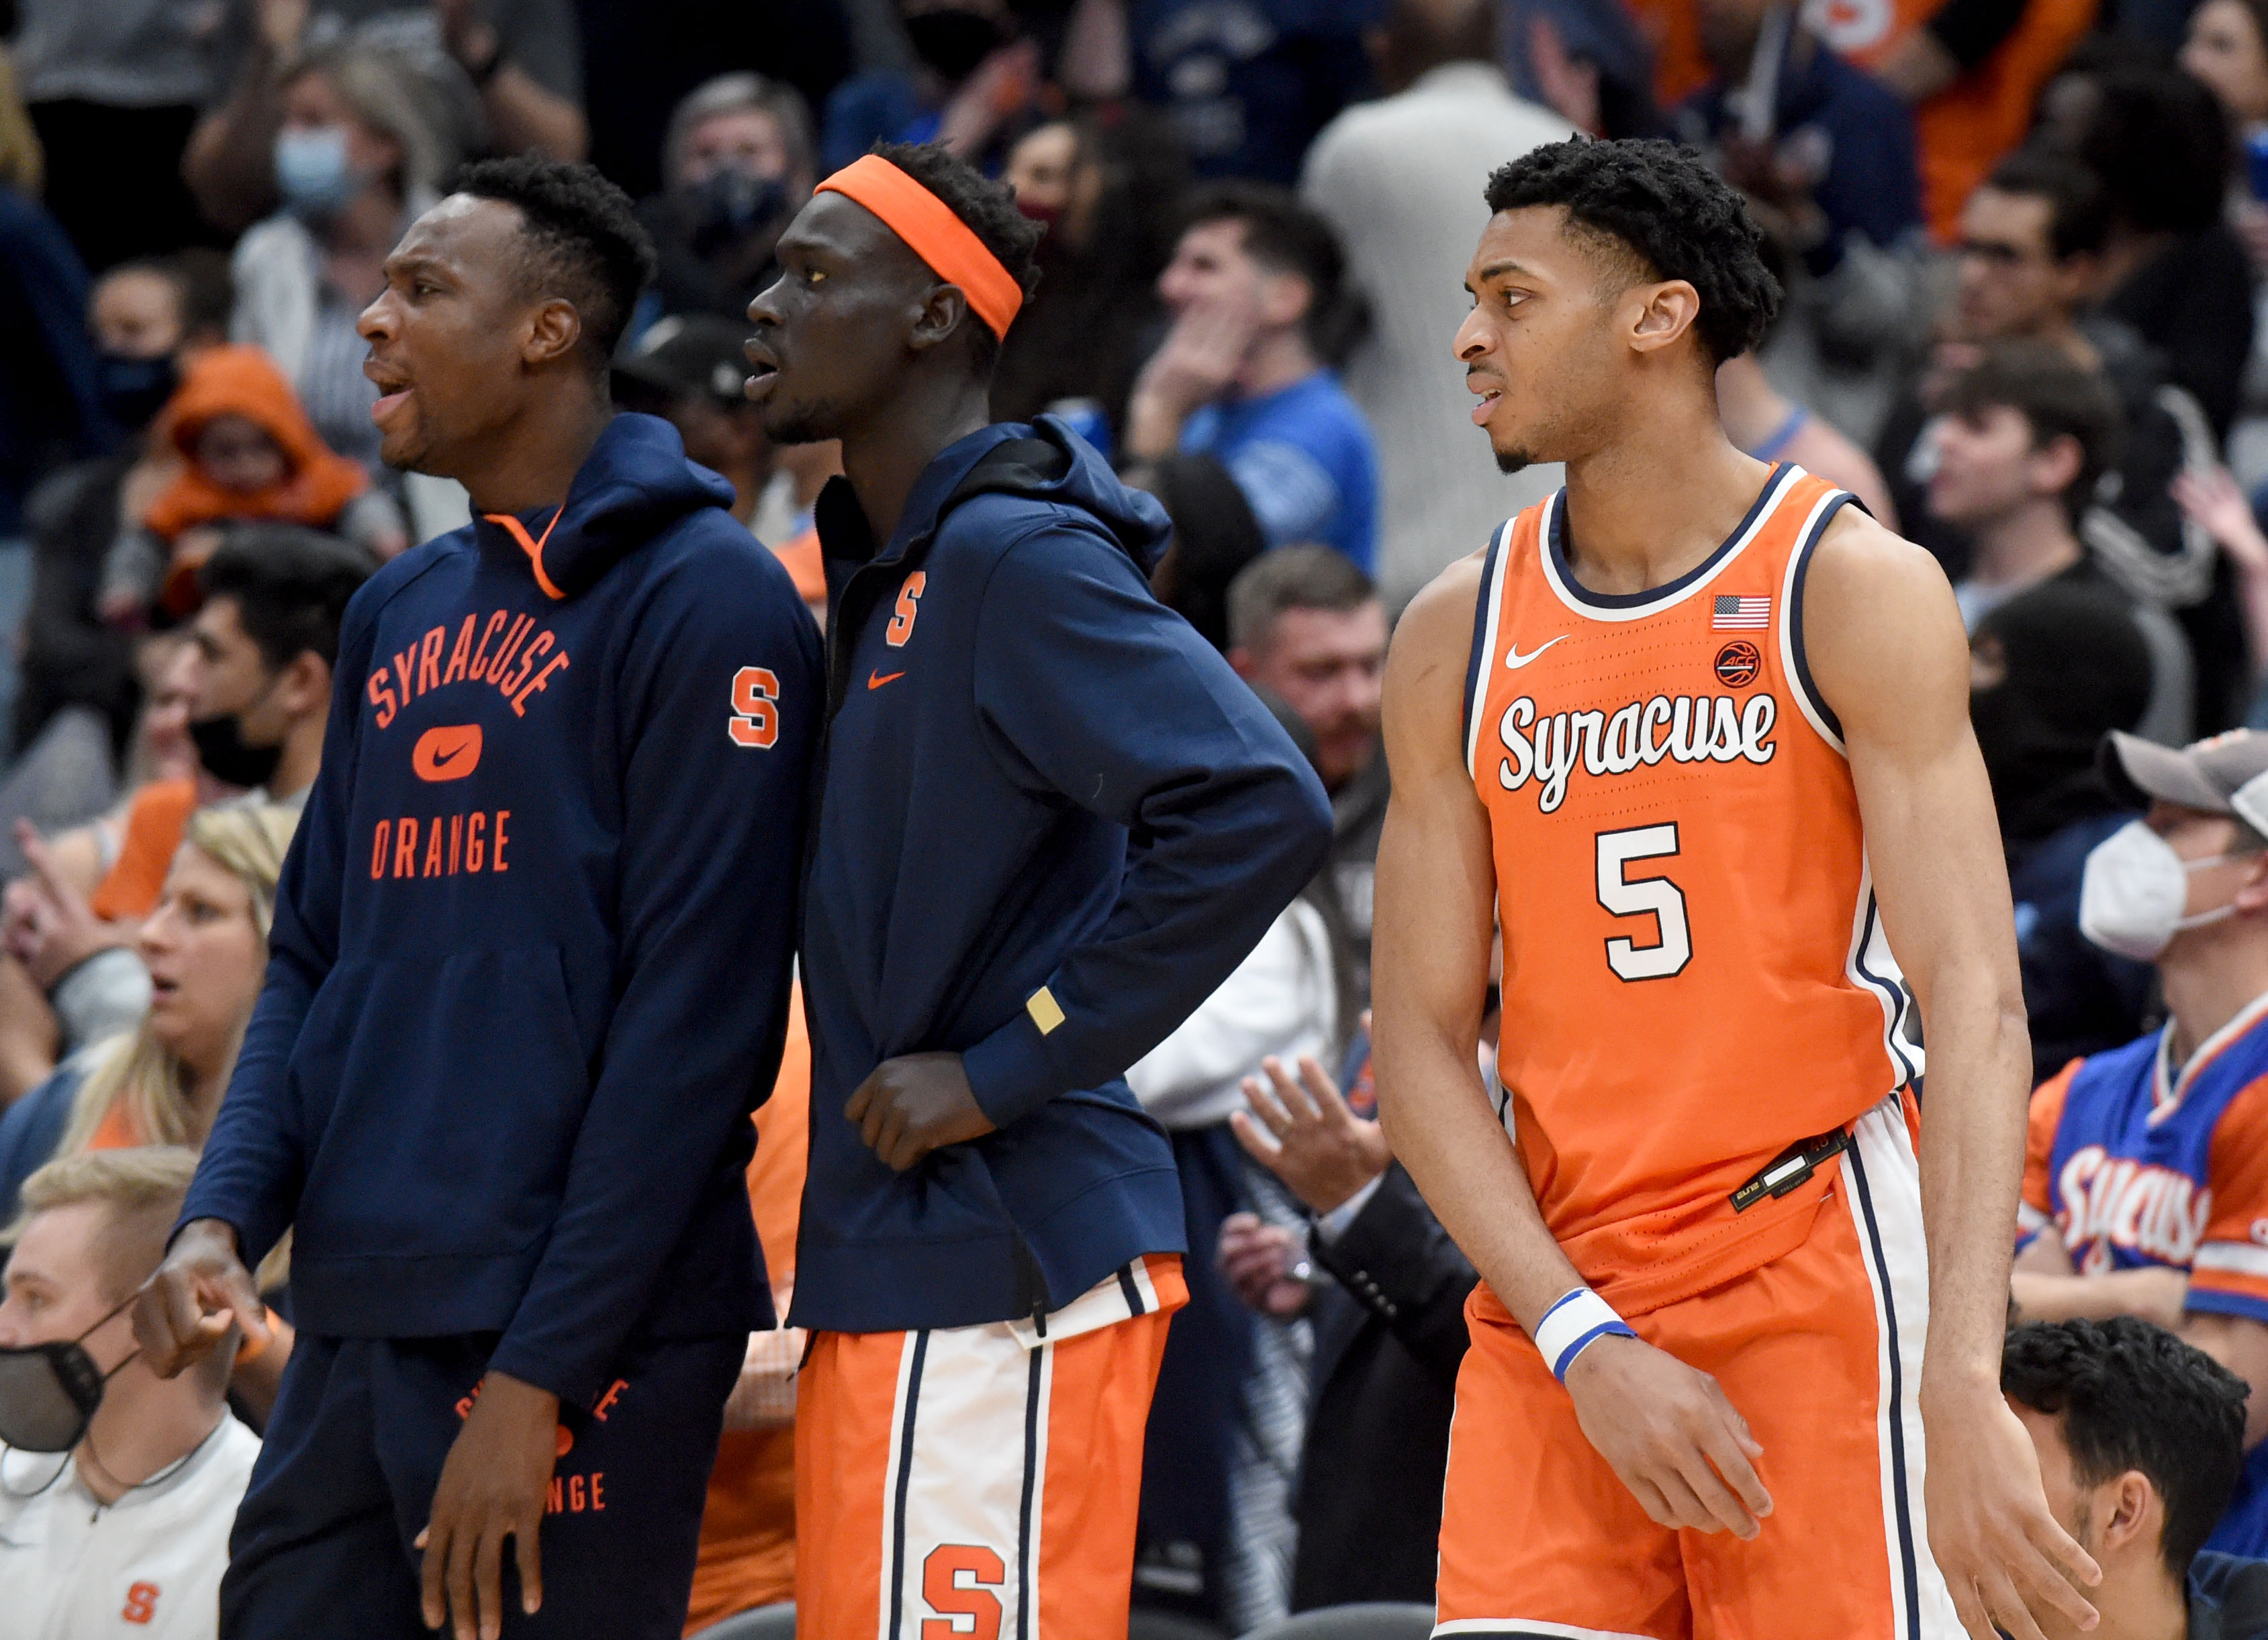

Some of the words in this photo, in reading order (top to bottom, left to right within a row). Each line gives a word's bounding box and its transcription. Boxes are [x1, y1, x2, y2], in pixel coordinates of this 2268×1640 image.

[886, 571, 927, 647] S
[367, 609, 570, 730] SYRACUSE
[728, 666, 779, 749] S
[1499, 693, 1777, 814] Syracuse
[371, 810, 511, 879] ORANGE
[1595, 821, 1693, 983] 5
[547, 1472, 606, 1514] NGE
[920, 1543, 1006, 1640] S
